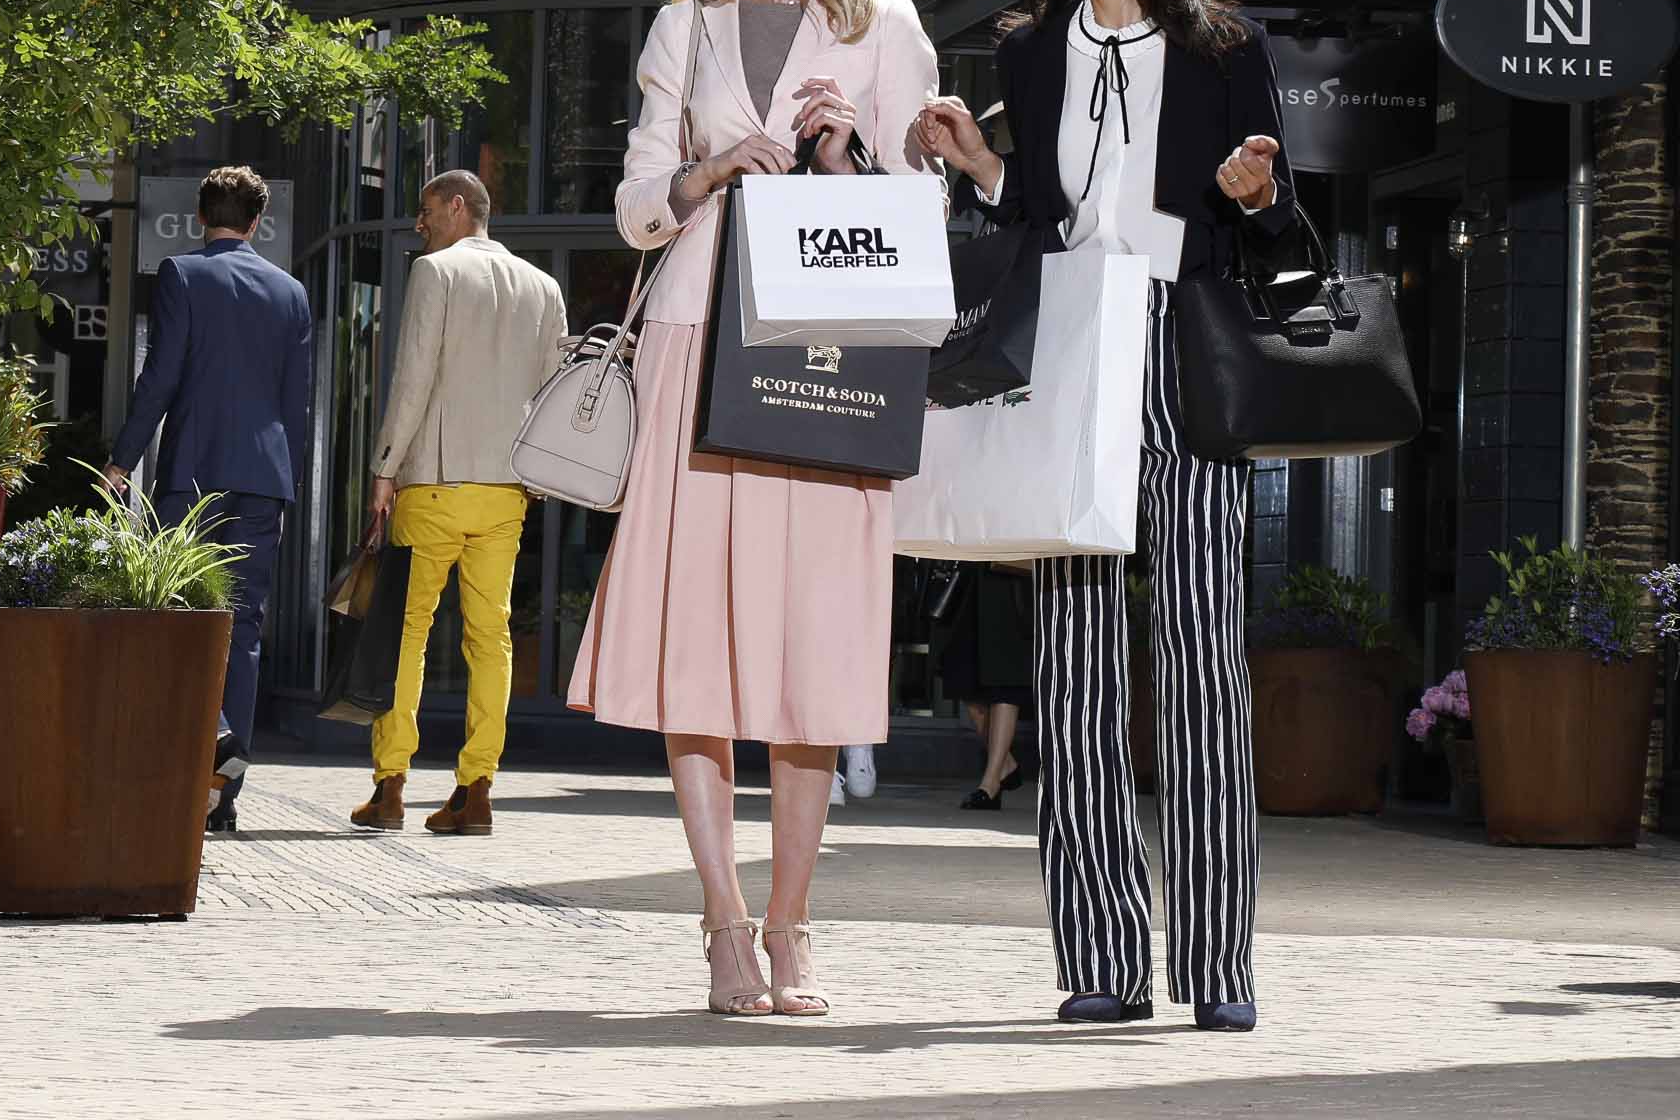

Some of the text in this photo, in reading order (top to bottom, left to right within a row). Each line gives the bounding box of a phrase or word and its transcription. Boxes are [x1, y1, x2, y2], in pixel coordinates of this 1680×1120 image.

[1501, 55, 1614, 78] NIKKIE
[1340, 91, 1427, 109] perfumes
[154, 212, 276, 242] GUS
[797, 227, 898, 255] KARL
[32, 247, 89, 273] ESS
[800, 254, 899, 269] LAGERFELD
[760, 394, 877, 419] AMSTERDAM COUTURE
